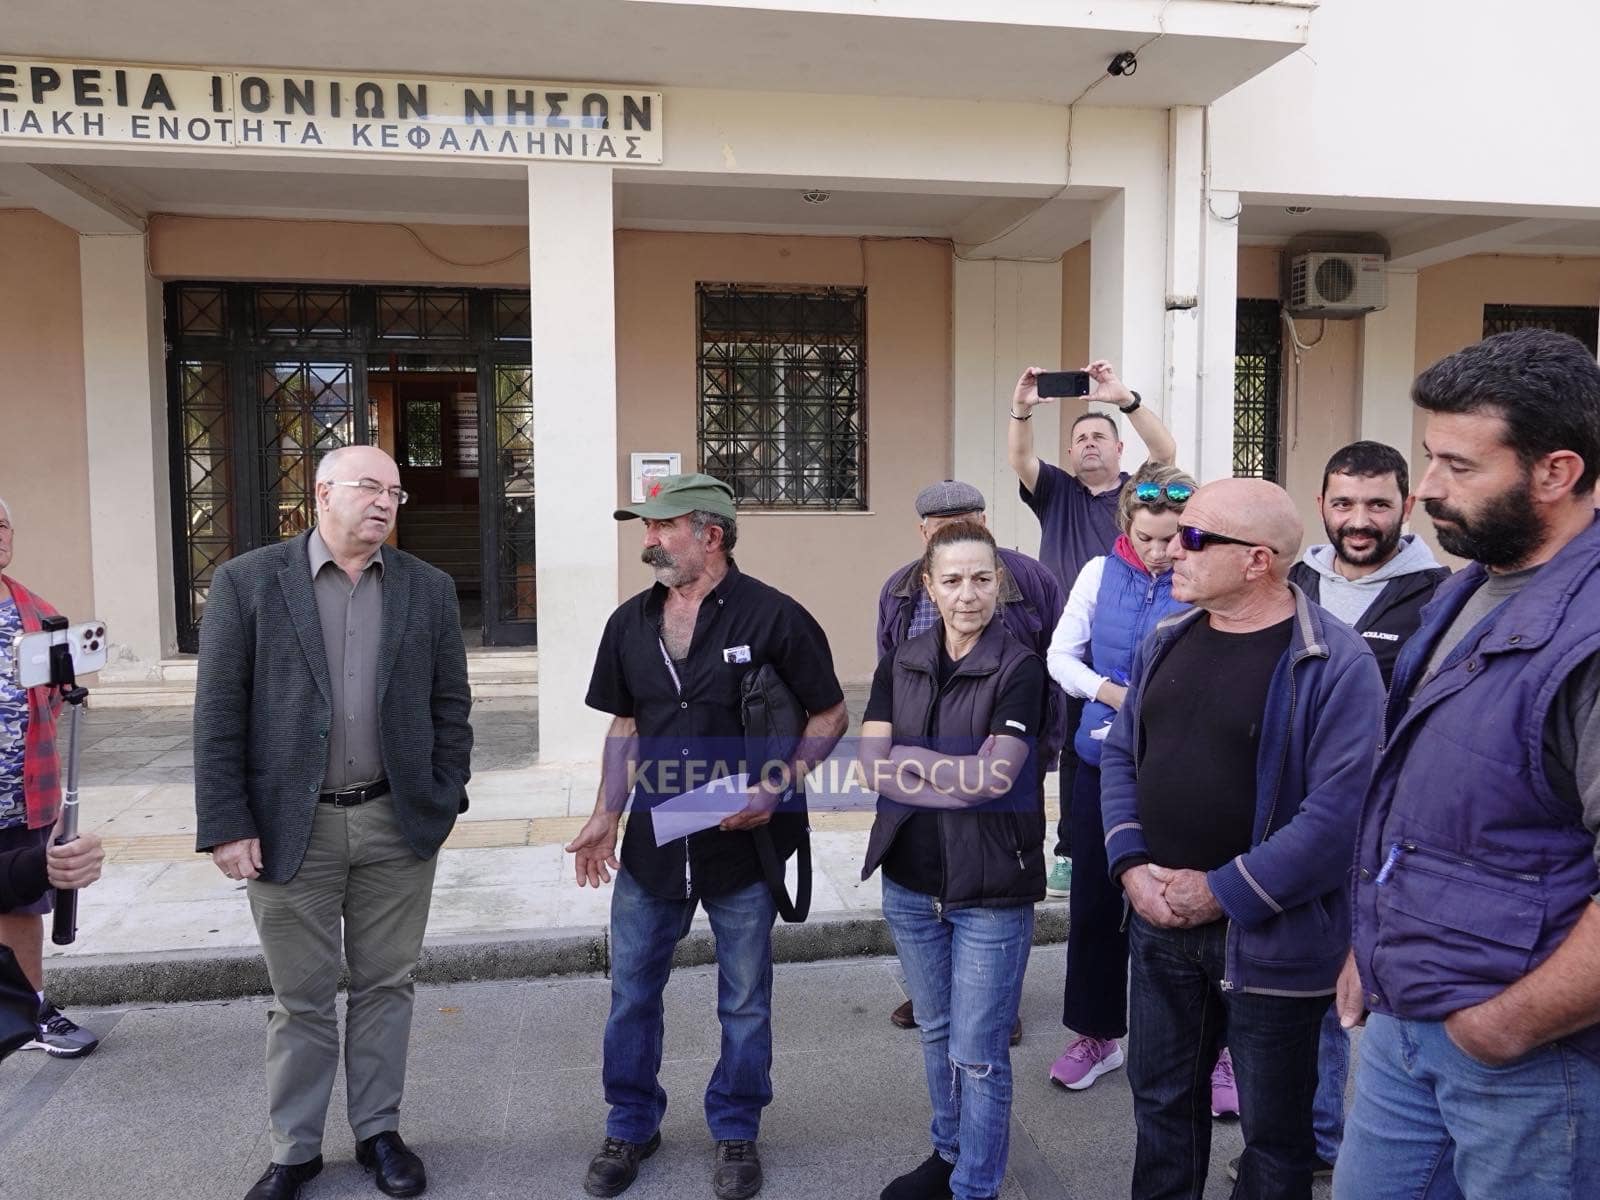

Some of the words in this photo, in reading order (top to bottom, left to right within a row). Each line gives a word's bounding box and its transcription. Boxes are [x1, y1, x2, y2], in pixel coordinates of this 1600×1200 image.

[211, 75, 428, 119] ΙΟΝΙΩΝ
[464, 88, 652, 131] ΝΗΣΩΝ
[3, 108, 104, 136] ΙΑΚΗ
[131, 115, 323, 144] ΕΝΟΤΗΤΑ
[352, 123, 642, 159] ΚΕΦΑΛΛΗΝΙΑΣ
